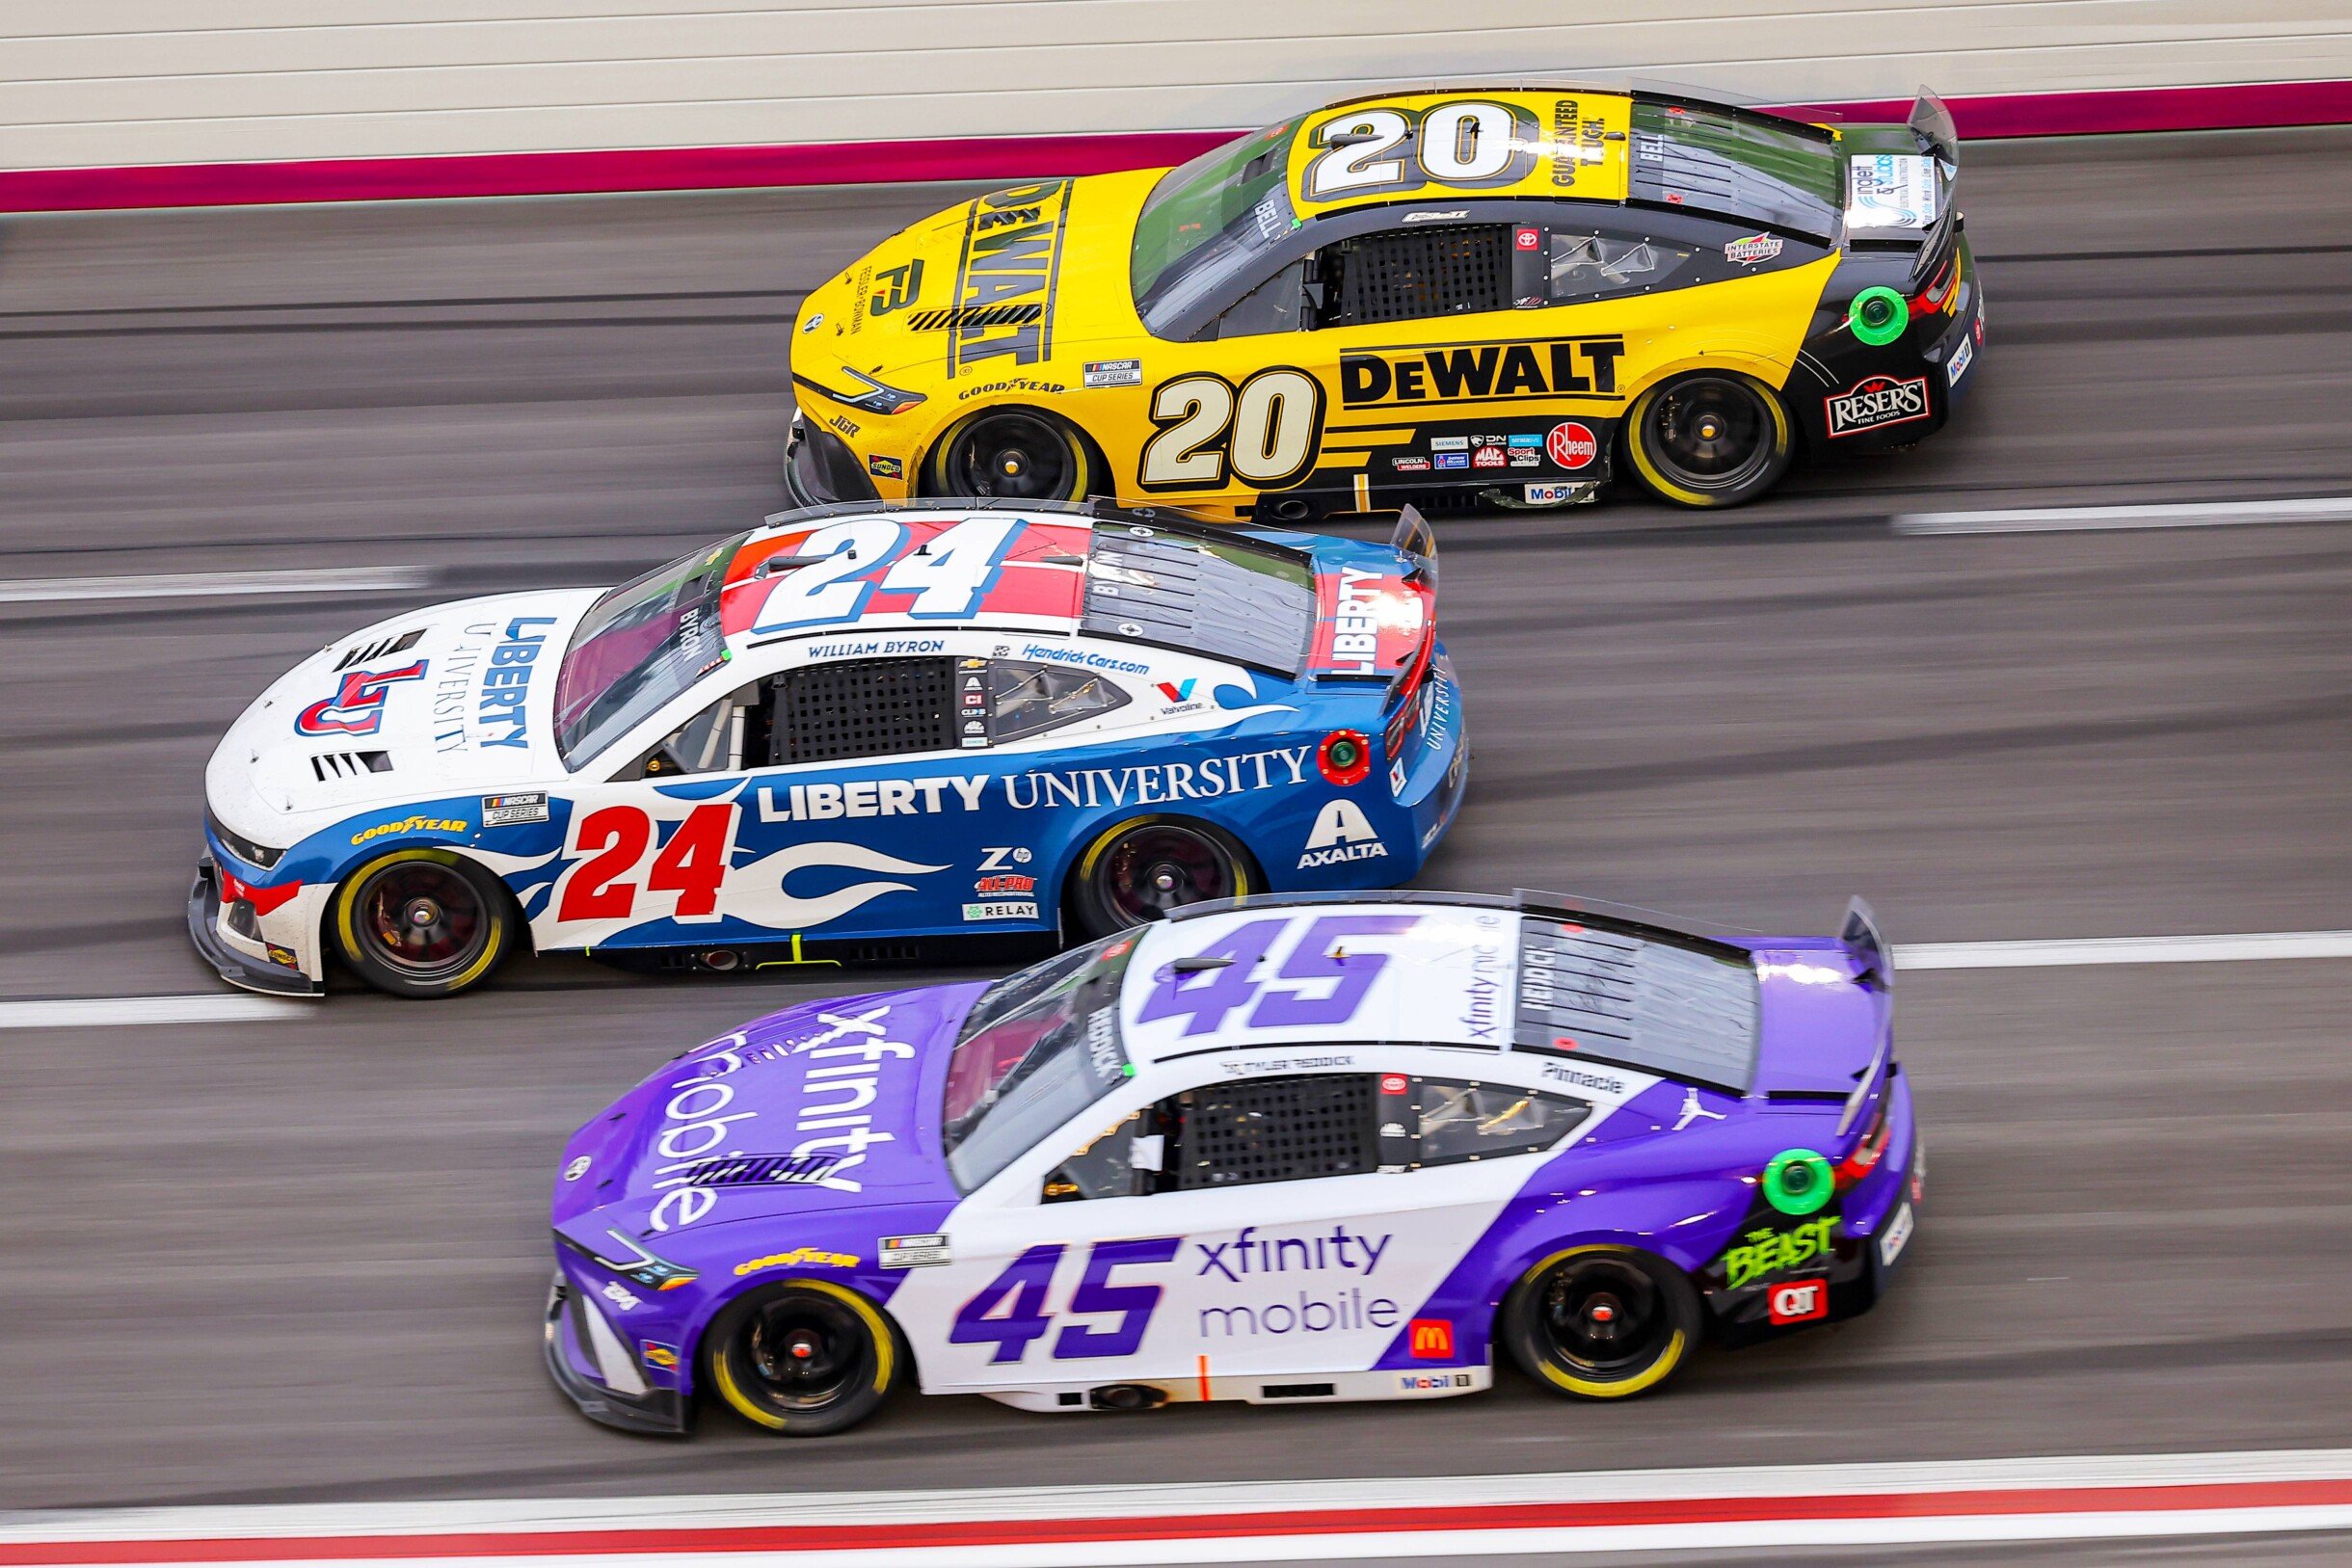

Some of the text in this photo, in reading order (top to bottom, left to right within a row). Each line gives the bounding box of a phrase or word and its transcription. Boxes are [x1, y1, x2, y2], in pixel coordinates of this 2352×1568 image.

[1307, 99, 1519, 199] 20
[1581, 118, 1605, 166] TUGH.
[1640, 134, 1664, 162] BELL
[1255, 199, 1281, 239] BELL
[1726, 240, 1781, 253] INTERSTATE
[1730, 248, 1779, 260] BATTERIES
[1092, 371, 1134, 382] CUP SERIES
[1099, 360, 1133, 372] NASCAR
[958, 377, 1065, 400] GOODYEAR
[829, 414, 861, 438] JGR
[1136, 365, 1327, 493] 20
[1857, 410, 1901, 425] FINE FOODS
[1475, 447, 1504, 461] MAC
[1508, 447, 1534, 456] Sport
[1554, 423, 1593, 461] Rheem
[870, 462, 901, 474] SUNOCO
[750, 518, 1030, 635] 24
[680, 607, 705, 661] BYRON
[1330, 567, 1384, 676] LIBERTY
[808, 639, 945, 658] WILLIAM BYRON
[480, 617, 557, 749] LIBERTY
[1161, 703, 1203, 715] Valvoline
[1427, 664, 1447, 751] UNIVERSITY
[759, 746, 1312, 823] LIBERTY UNIVERSITY
[492, 807, 539, 819] CUP SERIES
[502, 795, 539, 806] NASCAR
[351, 815, 468, 846] GOODYEAR
[557, 804, 733, 922] 24
[976, 847, 1029, 871] Z hp
[1296, 842, 1388, 869] AXALTA
[978, 876, 1033, 891] ALL-PRO
[985, 906, 1033, 916] RELAY
[270, 950, 296, 962] SUNOCO
[1136, 916, 1421, 1037] 45
[1458, 976, 1501, 1039] xfinity
[1541, 1061, 1625, 1094] Pinnacle
[770, 1005, 916, 1192] xfinity
[1196, 1226, 1393, 1283] xfinity
[1722, 1216, 1841, 1290] BEAST
[948, 1235, 1187, 1366] 45
[1200, 1288, 1402, 1338] mobile
[1774, 1286, 1819, 1316] QT
